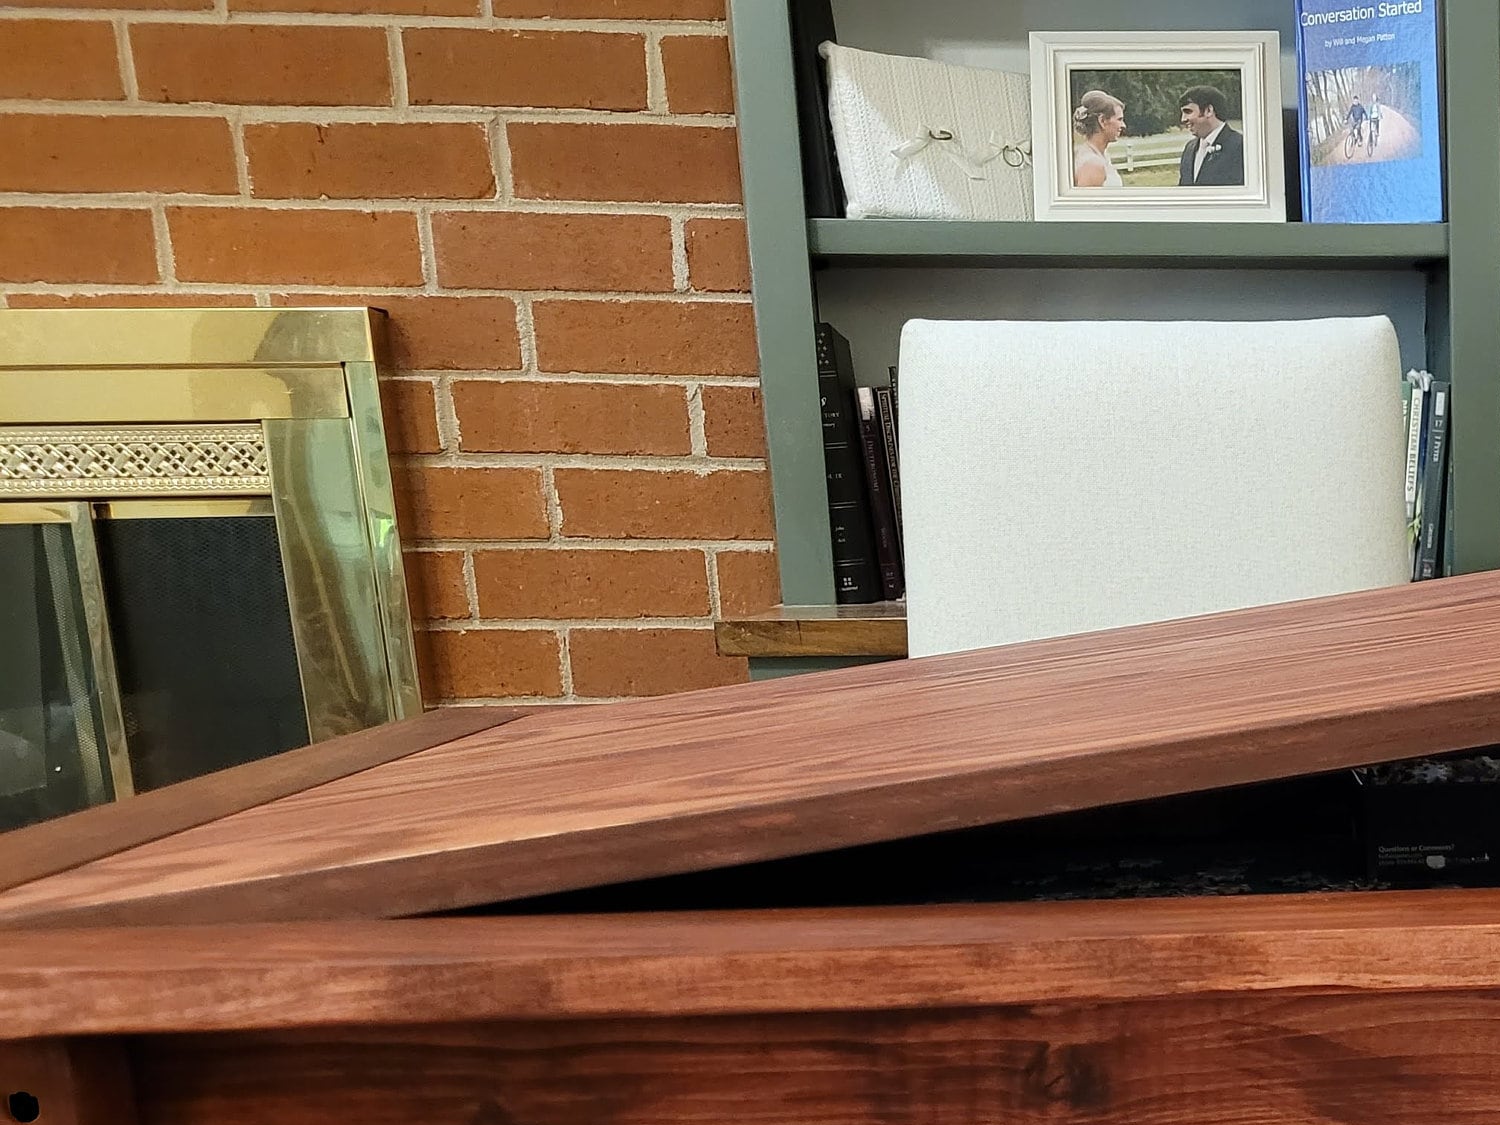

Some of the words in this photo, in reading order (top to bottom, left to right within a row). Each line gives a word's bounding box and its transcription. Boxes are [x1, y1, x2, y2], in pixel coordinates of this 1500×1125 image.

[1301, 6, 1375, 27] Conversation
[1378, 0, 1422, 17] Started
[1324, 40, 1333, 48] by
[1345, 37, 1356, 45] and
[1409, 397, 1420, 451] CHRISTIAN
[1435, 419, 1443, 427] 17
[1407, 453, 1416, 492] BELIEFS
